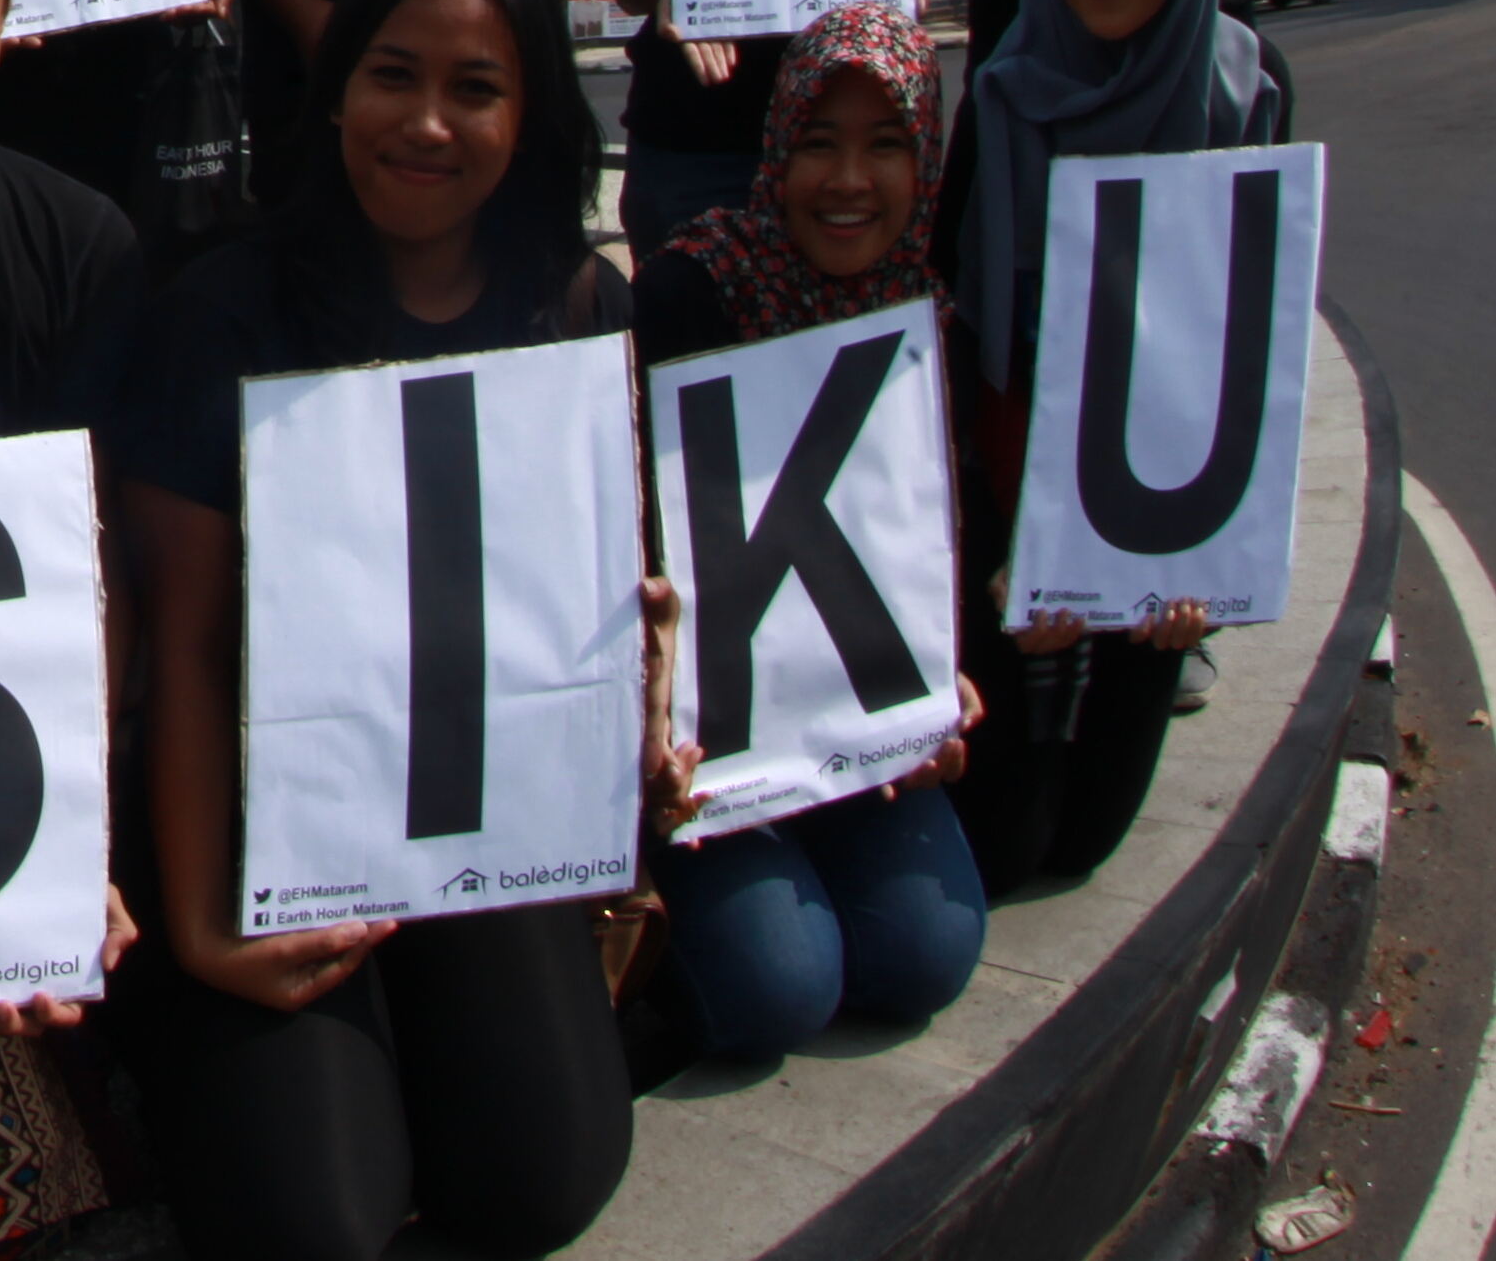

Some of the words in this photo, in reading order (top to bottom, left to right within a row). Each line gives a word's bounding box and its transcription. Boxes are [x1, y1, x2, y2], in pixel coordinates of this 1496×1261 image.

[16, 11, 55, 25] Mataram
[1077, 169, 1279, 555] U
[678, 329, 931, 762] K
[401, 371, 485, 840] I
[703, 805, 730, 820] Earth
[731, 798, 756, 813] Hour
[758, 786, 798, 804] Mataram
[713, 776, 768, 799] EHMataram
[499, 854, 628, 889] balèdigital
[277, 883, 368, 905] @EHMataram
[277, 910, 312, 925] Earth
[315, 906, 348, 921] Hour
[352, 900, 409, 917] Mataram
